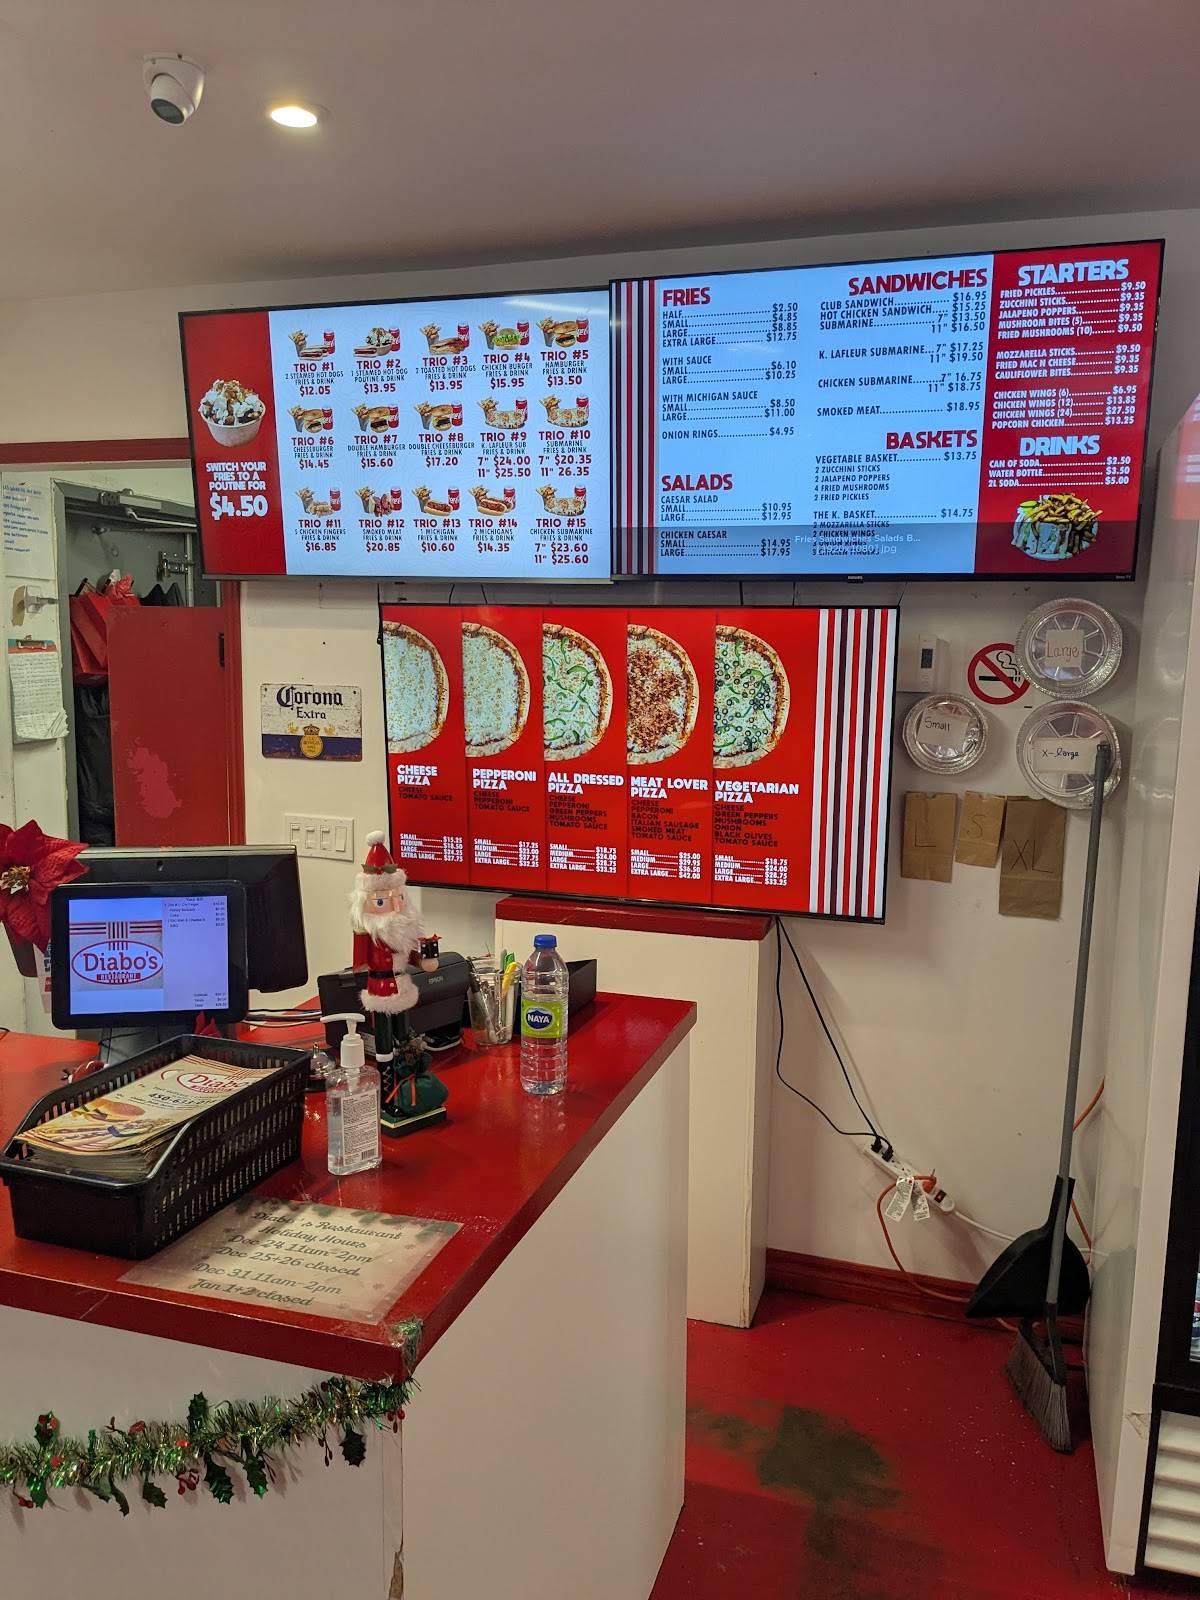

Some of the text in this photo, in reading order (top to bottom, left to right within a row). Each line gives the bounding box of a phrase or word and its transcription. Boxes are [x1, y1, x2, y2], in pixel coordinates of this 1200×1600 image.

[1018, 259, 1128, 286] STARTERS
[849, 268, 987, 296] SANDWICHES
[1000, 281, 1146, 298] FRIED PICKLES $9.50
[663, 287, 710, 307] FRIES
[821, 291, 986, 310] CLUB SANDWICH $16.95
[663, 303, 798, 319] HALF $2.50
[821, 302, 986, 320] HOT CHICKEN SANDWICH $15.25
[663, 312, 797, 328] SMALL $4.85
[663, 322, 797, 338] LARGE $8.85
[663, 332, 797, 347] EXTRA LARGE $12.75
[483, 353, 530, 363] TRIO #4
[541, 350, 588, 361] TRIO #5
[819, 345, 924, 359] K. LAFLEUR SUBMARINE
[997, 348, 1075, 359] MOZZARELLA STICKS
[357, 359, 401, 369] TRIO #2
[423, 356, 468, 366] TRIO #3
[663, 356, 712, 365] WITH SAUCE
[294, 362, 334, 372] TRIO #1
[663, 361, 796, 375] SMALL $6.10
[663, 370, 795, 385] LARGE $10.25
[995, 368, 1071, 379] CAULIFLOWER BITES
[430, 380, 462, 392] $13.95
[491, 378, 524, 389] $15.95
[548, 375, 582, 387] $13.50
[818, 375, 912, 388] CHICKEN SUBMARINE
[300, 386, 330, 397] $12.05
[364, 383, 395, 394] $13.95
[817, 402, 979, 416] SMOKED MEAT $18.95
[419, 433, 463, 442] TRIO #8
[480, 432, 526, 441] TRIO #9
[539, 430, 590, 441] TRIO #10
[662, 427, 794, 439] ONION RINGS $4.95
[292, 437, 334, 446] TRIO #6
[354, 435, 397, 444] TRIO #7
[886, 430, 977, 449] BASKETS
[1020, 435, 1100, 456] DRINKS
[361, 459, 393, 468] $15.60
[426, 456, 458, 468] $17.20
[816, 451, 977, 464] VEGETABLE BASKET $13.75
[989, 456, 1130, 468] CAN OF SODA $2.50
[206, 462, 266, 471] SWITCH YOUR
[300, 460, 329, 470] $14.45
[214, 472, 260, 481] FRIES TO A
[209, 481, 266, 490] POUTINE FOR
[662, 474, 732, 492] SALADS
[694, 495, 718, 503] SALAD
[210, 492, 268, 520] $4.50
[298, 520, 341, 528] TRIO #11
[359, 519, 405, 528] TRIO #12
[414, 519, 460, 527] TRIO #13
[469, 519, 517, 527] TRIO #14
[536, 518, 586, 527] TRIO #15
[305, 542, 336, 552] $16.85
[366, 542, 400, 553] $20.85
[422, 542, 454, 552] $10.60
[478, 542, 509, 553] $14.35
[535, 542, 588, 554] 7" $23.60
[535, 554, 588, 565] 11" $25.60
[1047, 641, 1079, 662] Large
[277, 686, 343, 710] Corona
[297, 707, 326, 719] Extra
[925, 717, 950, 732] Small
[1042, 748, 1079, 760] X-large
[397, 764, 437, 776] CHEESE
[473, 768, 536, 782] PEPPERONI
[397, 775, 430, 786] PIZZA
[473, 779, 507, 790] PIZZA
[549, 772, 624, 786] ALL DRESSED
[631, 776, 708, 790] MEAT LOVER
[548, 783, 583, 794] PIZZA
[631, 787, 667, 799] PIZZA
[715, 780, 799, 795] VEGETARIAN
[715, 792, 753, 803] PIZZA
[967, 815, 986, 838] S
[915, 822, 936, 847] L
[1010, 839, 1053, 873] XL
[83, 951, 158, 971] Diabo's
[527, 1014, 550, 1023] NAYA
[315, 1221, 402, 1240] Restaurant
[259, 1226, 368, 1248] Holiday Hours
[228, 1234, 375, 1263] Dec 24 11am-2pm
[216, 1246, 248, 1258] Dec
[250, 1252, 303, 1266] 25+26
[192, 1263, 343, 1295] Dec 31 11am-2pm
[189, 1279, 220, 1291] Jan
[255, 1290, 314, 1306] closed
